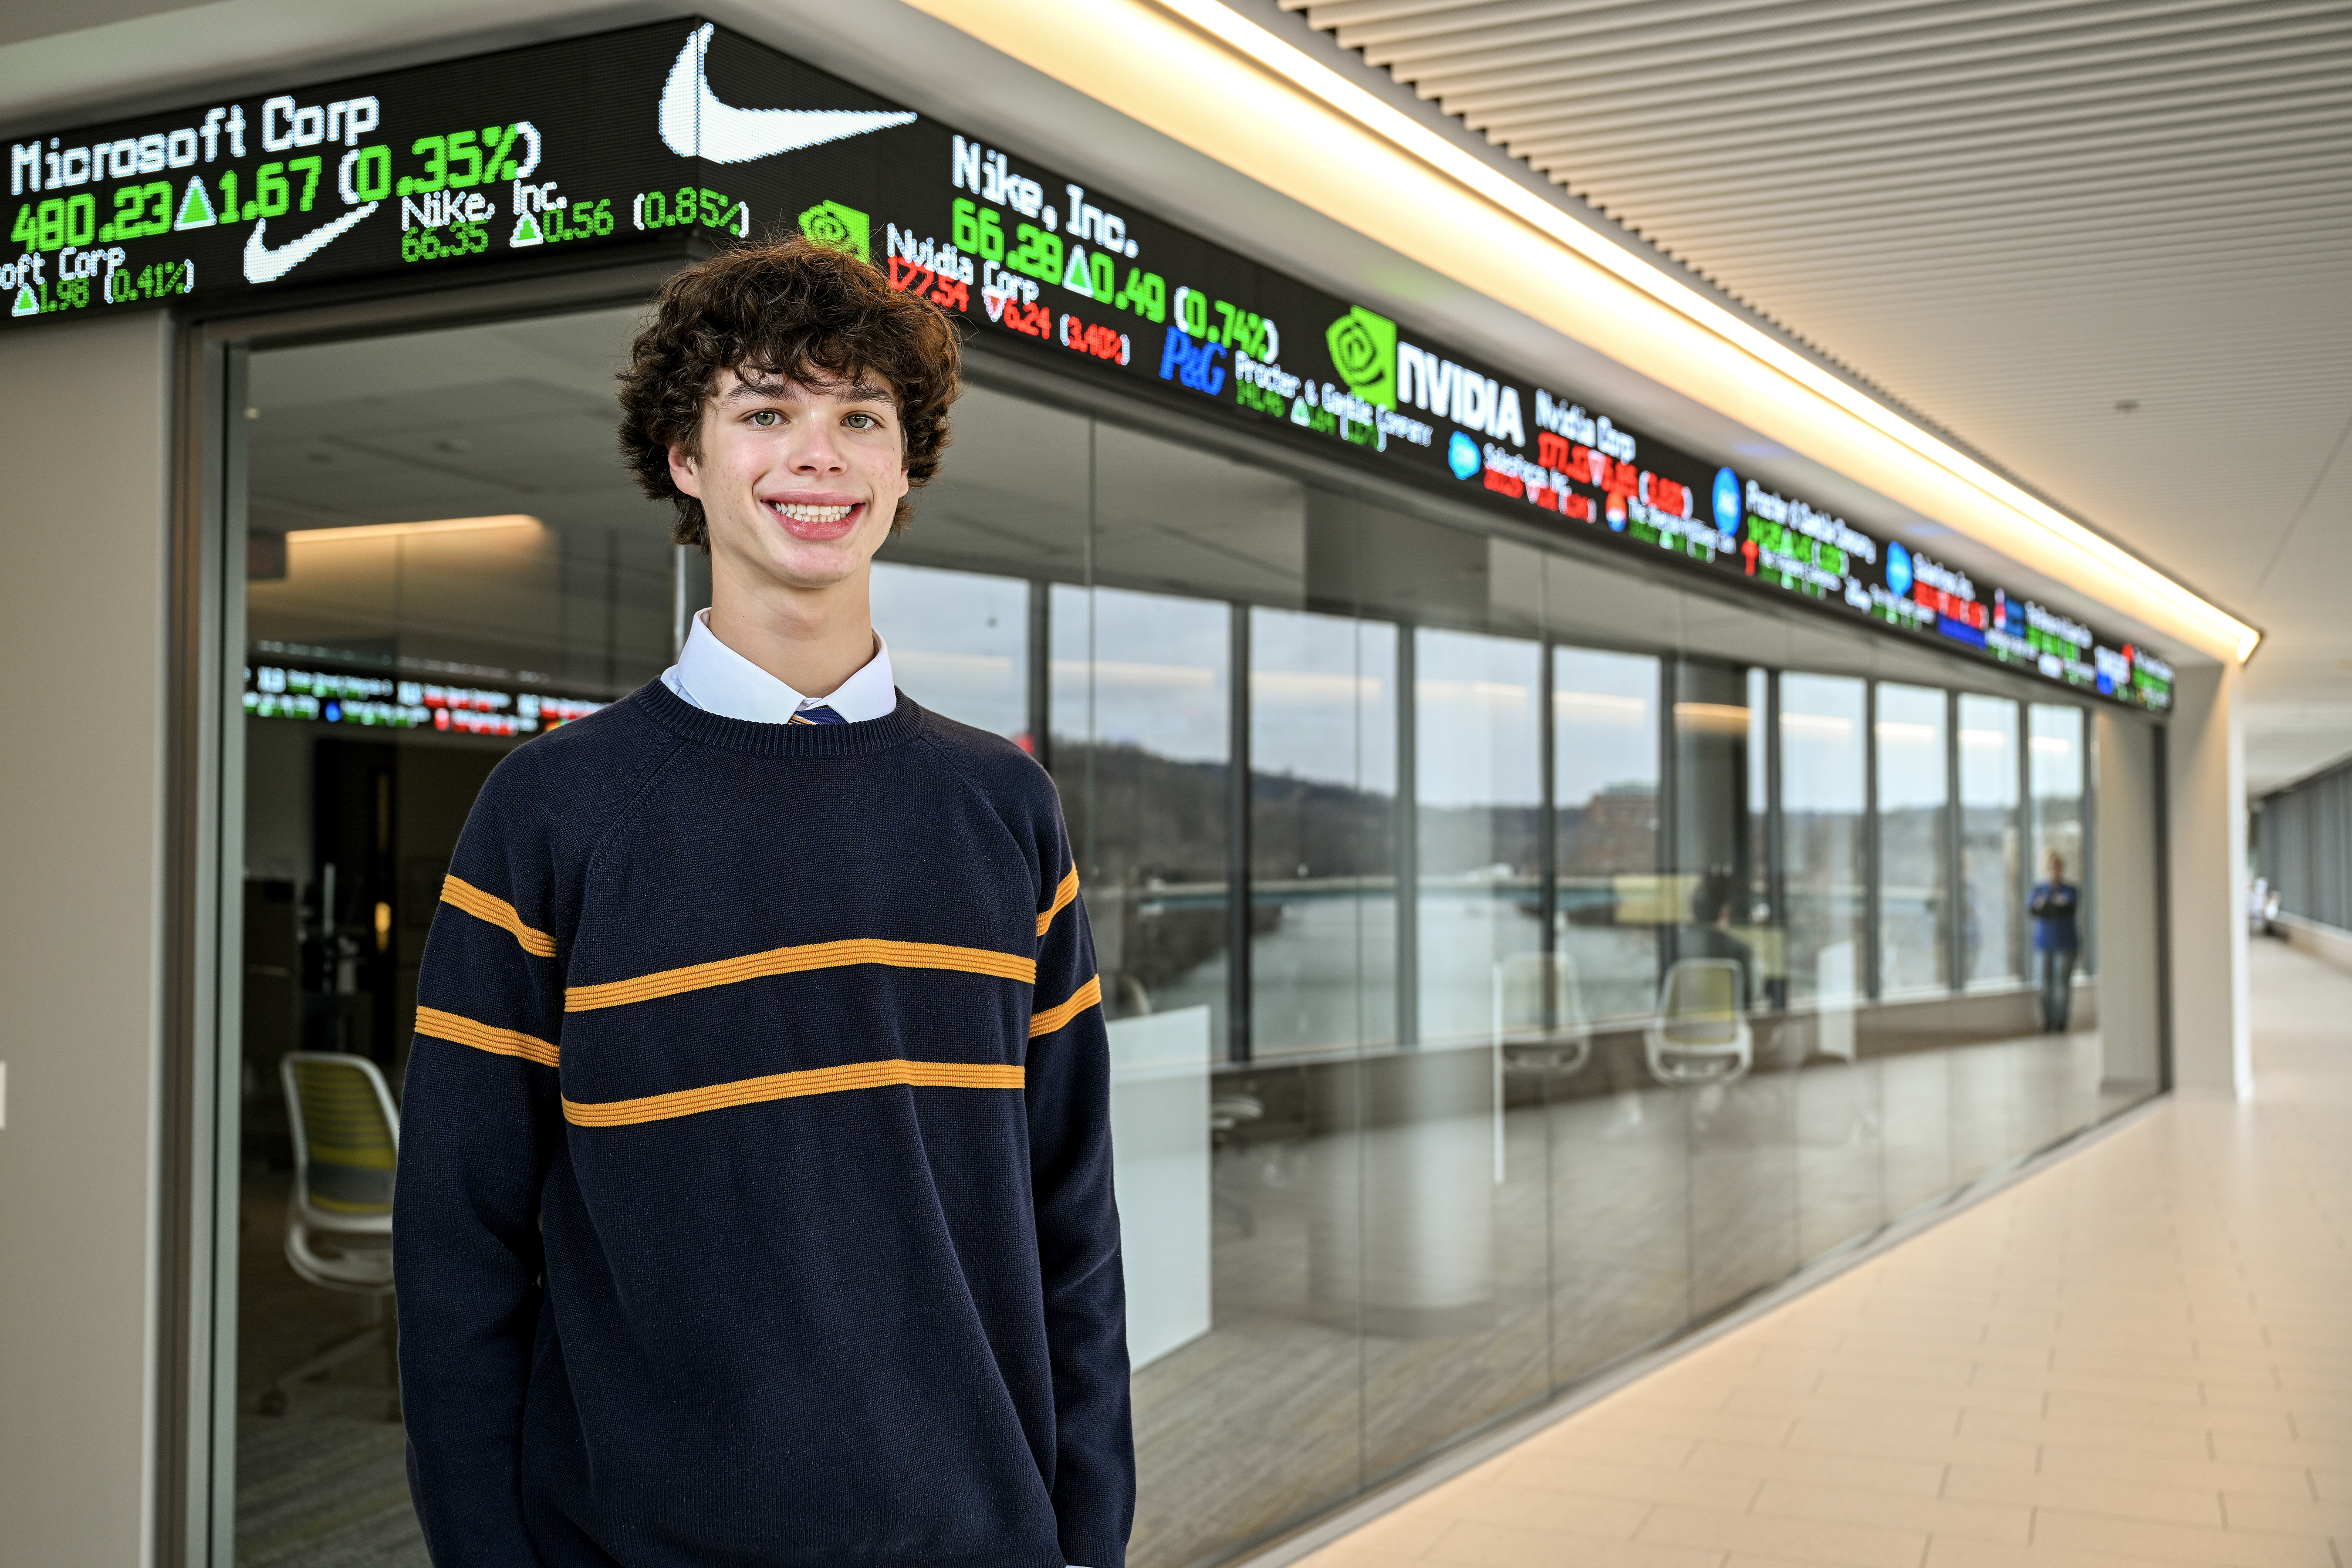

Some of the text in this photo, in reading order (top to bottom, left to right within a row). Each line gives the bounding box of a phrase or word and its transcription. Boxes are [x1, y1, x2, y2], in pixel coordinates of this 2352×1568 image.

[11, 95, 379, 195] Microsoft Corp
[11, 122, 541, 253] 480.23 1.67 (0.35%)
[402, 186, 749, 262] 66.35 0.56 (0.85%)
[513, 179, 567, 215] Inc.
[953, 135, 1139, 258] Nike, Inc.
[0, 247, 125, 290] oft Corp
[39, 259, 195, 313] 1.98 (0.41%)
[887, 223, 1039, 305] Nvidia Corp
[953, 197, 1279, 364] 66.28 0.49 (0.74%)
[1004, 297, 1052, 340] 6.24
[1159, 325, 1227, 395] P&G
[1535, 389, 1636, 465] Nvidia Corp
